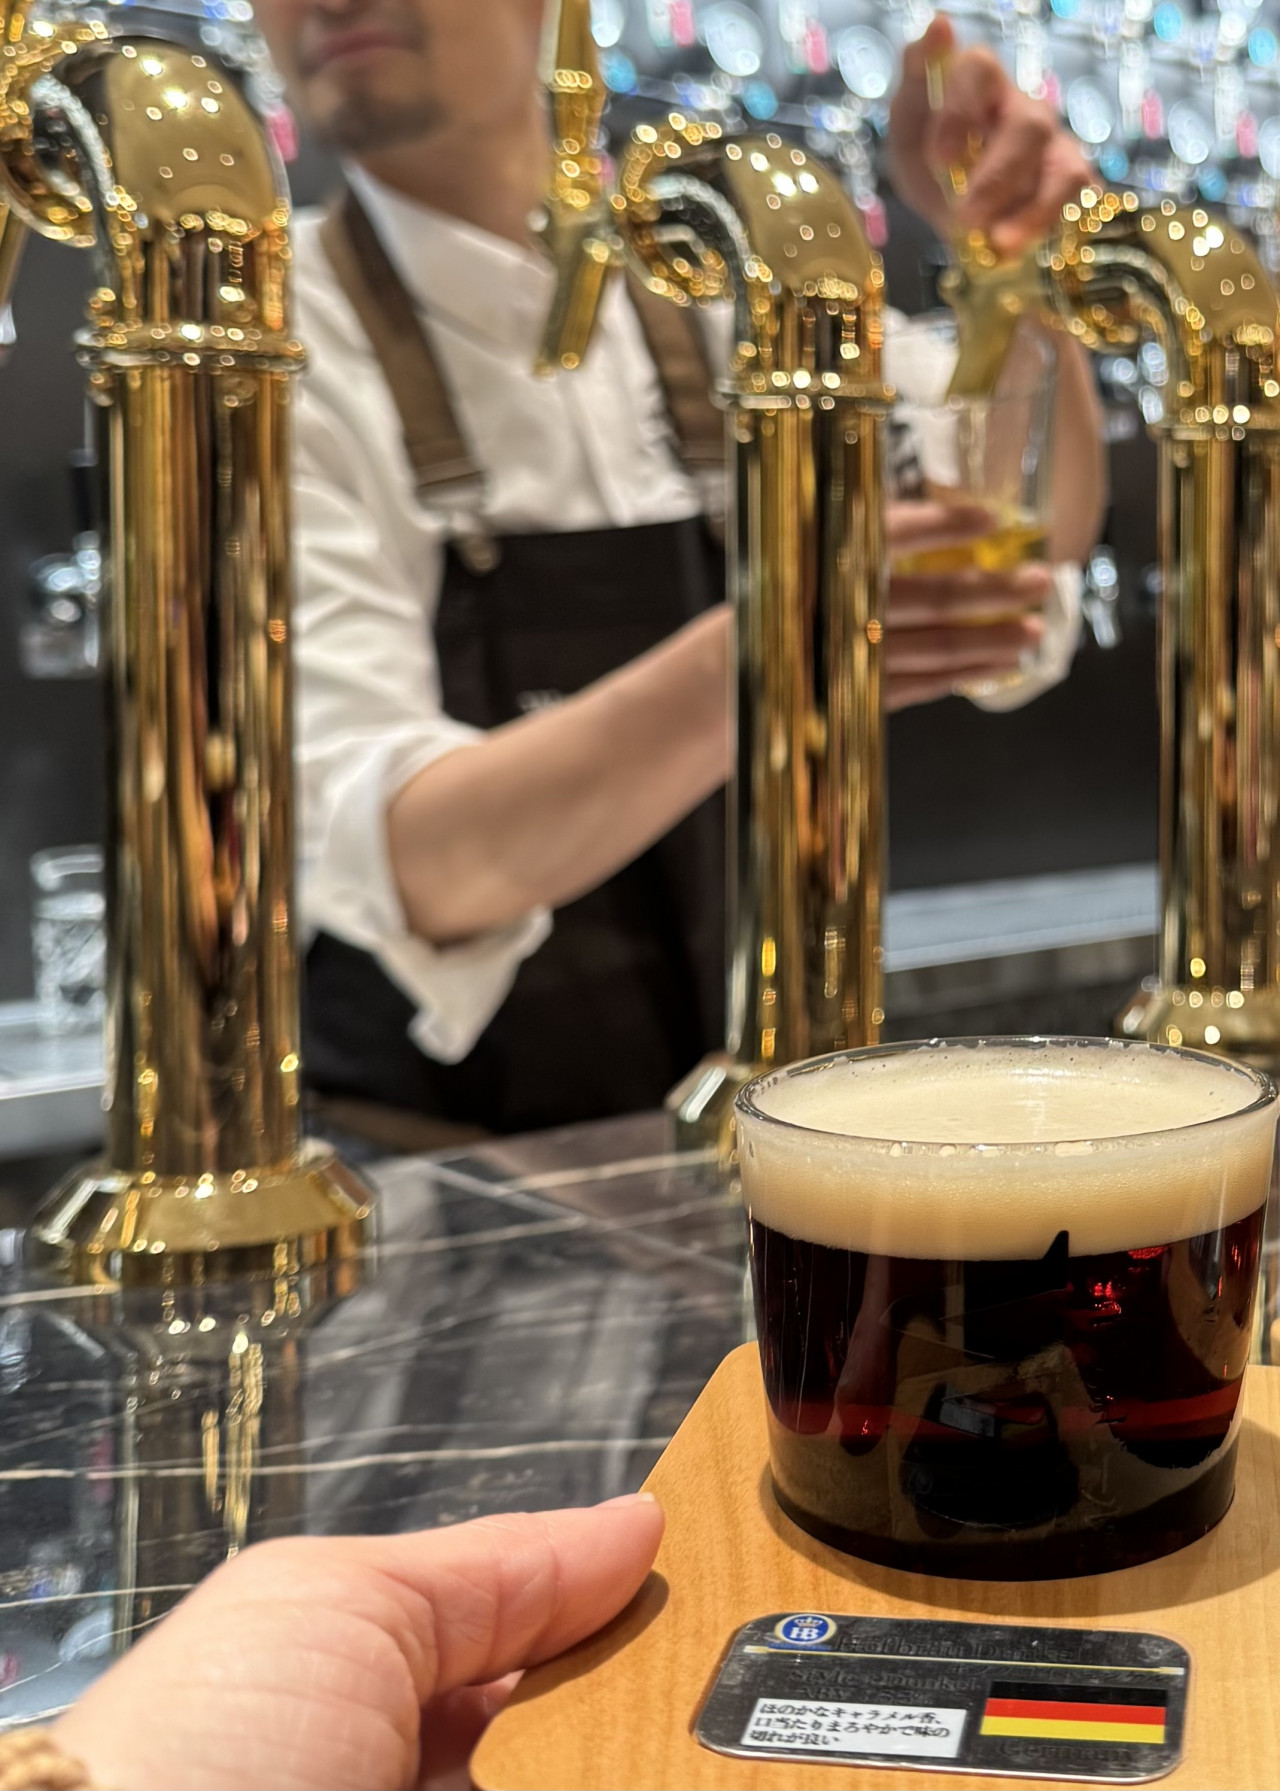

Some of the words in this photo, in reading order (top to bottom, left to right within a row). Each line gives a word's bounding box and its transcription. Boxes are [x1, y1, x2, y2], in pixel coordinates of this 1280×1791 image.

[789, 1627, 820, 1641] HB
[754, 1715, 950, 1739] 口当たりまろやかで味の
